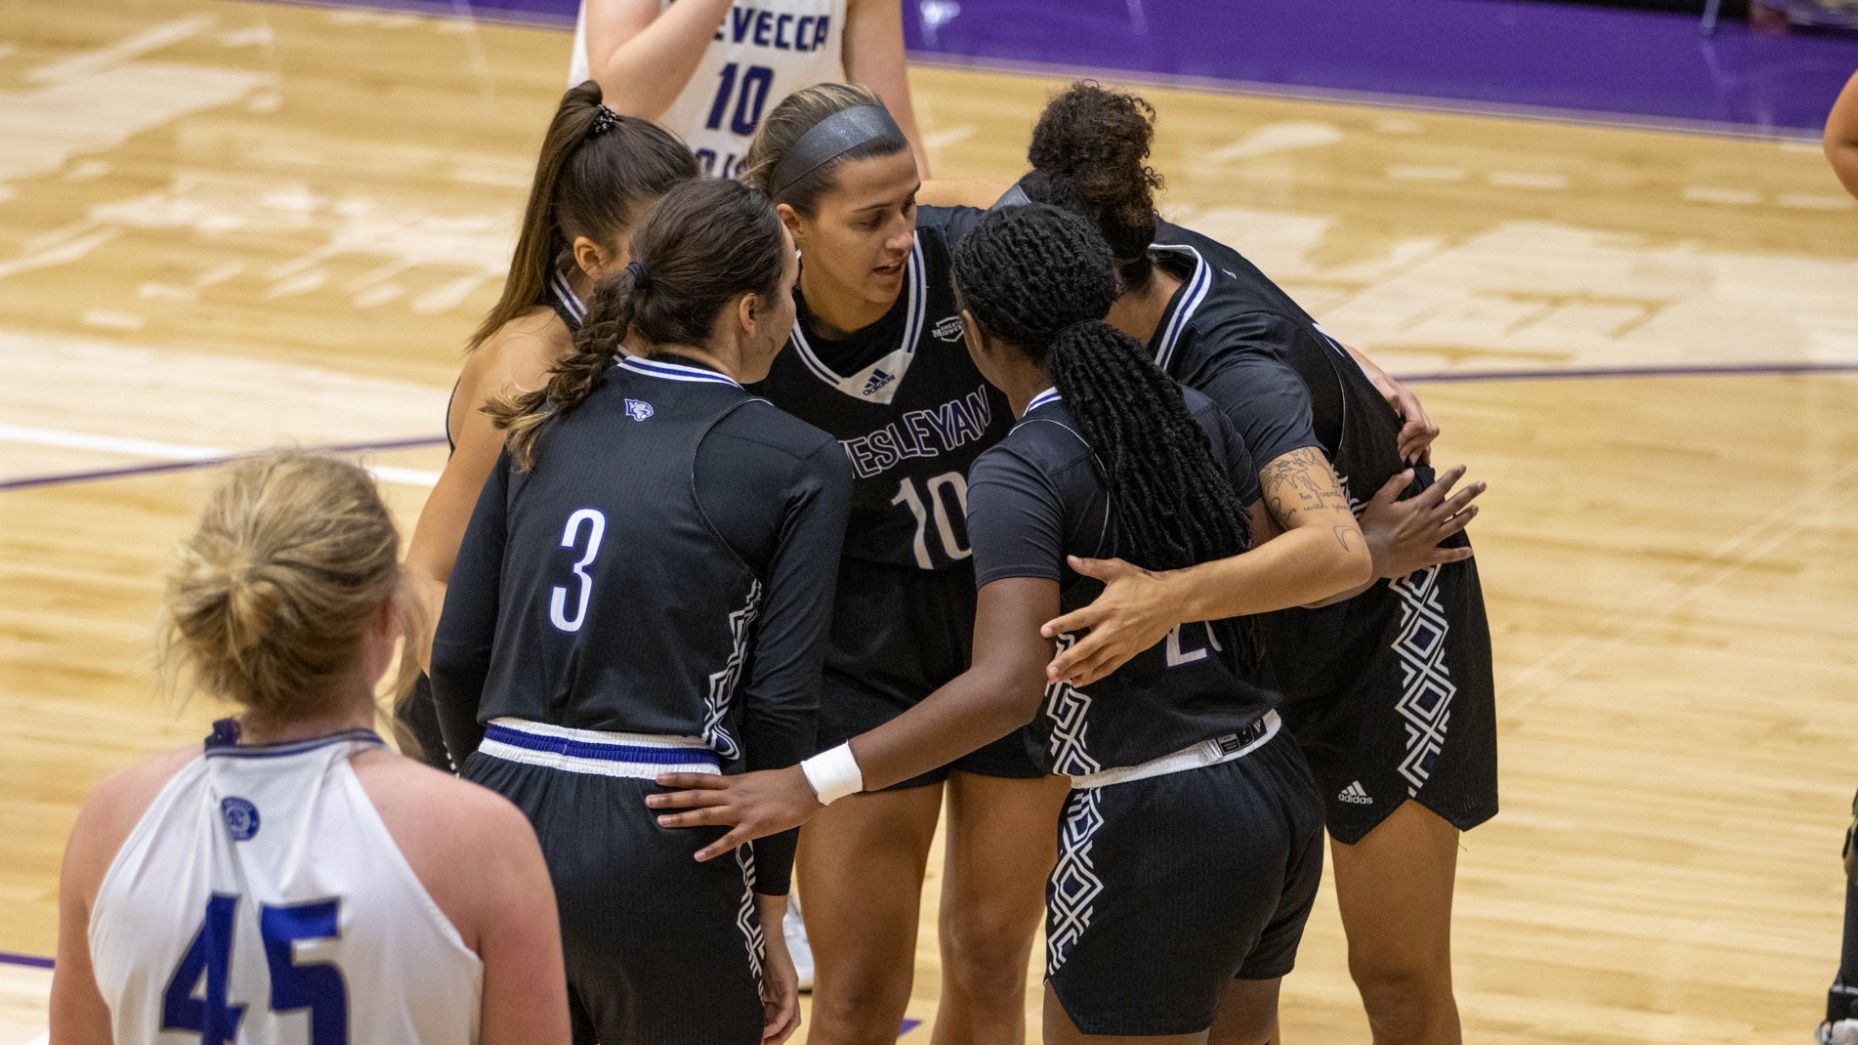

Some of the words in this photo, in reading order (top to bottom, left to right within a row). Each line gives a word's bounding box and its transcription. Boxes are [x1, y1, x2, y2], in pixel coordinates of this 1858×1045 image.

[705, 62, 775, 137] 10
[862, 374, 896, 396] adidas
[890, 471, 974, 570] 10
[549, 507, 608, 635] 3
[1338, 793, 1374, 805] adidas
[159, 890, 350, 1045] 45
